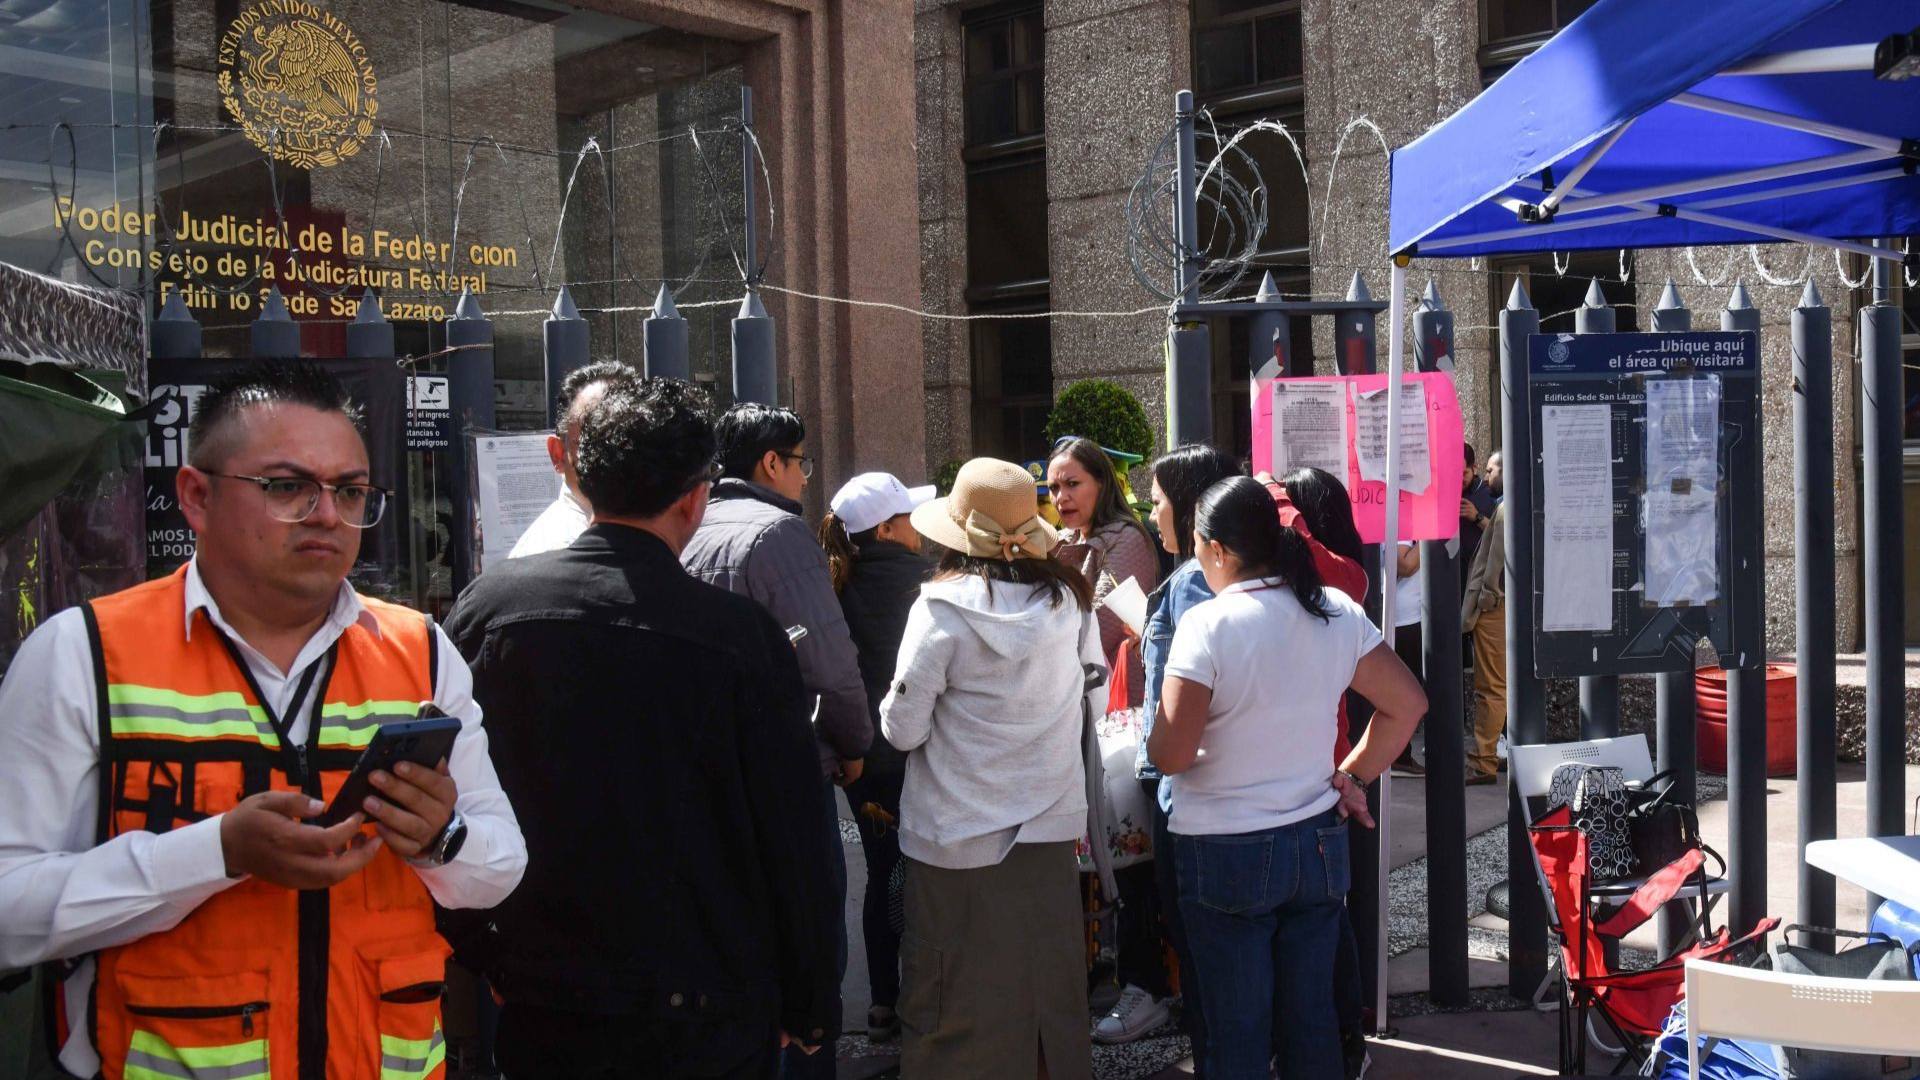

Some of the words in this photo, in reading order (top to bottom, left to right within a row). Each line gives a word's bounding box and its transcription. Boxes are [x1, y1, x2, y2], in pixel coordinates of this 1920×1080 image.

[219, 7, 261, 66] ESTADOS
[259, 0, 320, 20] UNIDOS
[322, 11, 378, 95] MEXICANOS
[54, 195, 157, 236] Poder
[175, 210, 289, 250] Judicial
[298, 223, 333, 254] de
[342, 226, 365, 257] la
[85, 239, 209, 280] Consejo
[217, 252, 248, 277] de
[254, 254, 276, 280] la
[284, 256, 403, 289] Judicatura
[409, 268, 487, 294] Federal
[330, 294, 362, 317] Sa
[1659, 339, 1710, 355] Ubique
[1714, 337, 1745, 354] aquí
[1608, 355, 1621, 368] el
[1625, 354, 1657, 368] área
[1690, 353, 1745, 367] visitará
[1544, 393, 1575, 402] Edificio
[1576, 393, 1597, 401] Sede
[1599, 393, 1615, 401] San
[1616, 392, 1645, 401] Lázaro
[418, 411, 424, 419] el
[416, 439, 449, 449] peligroso
